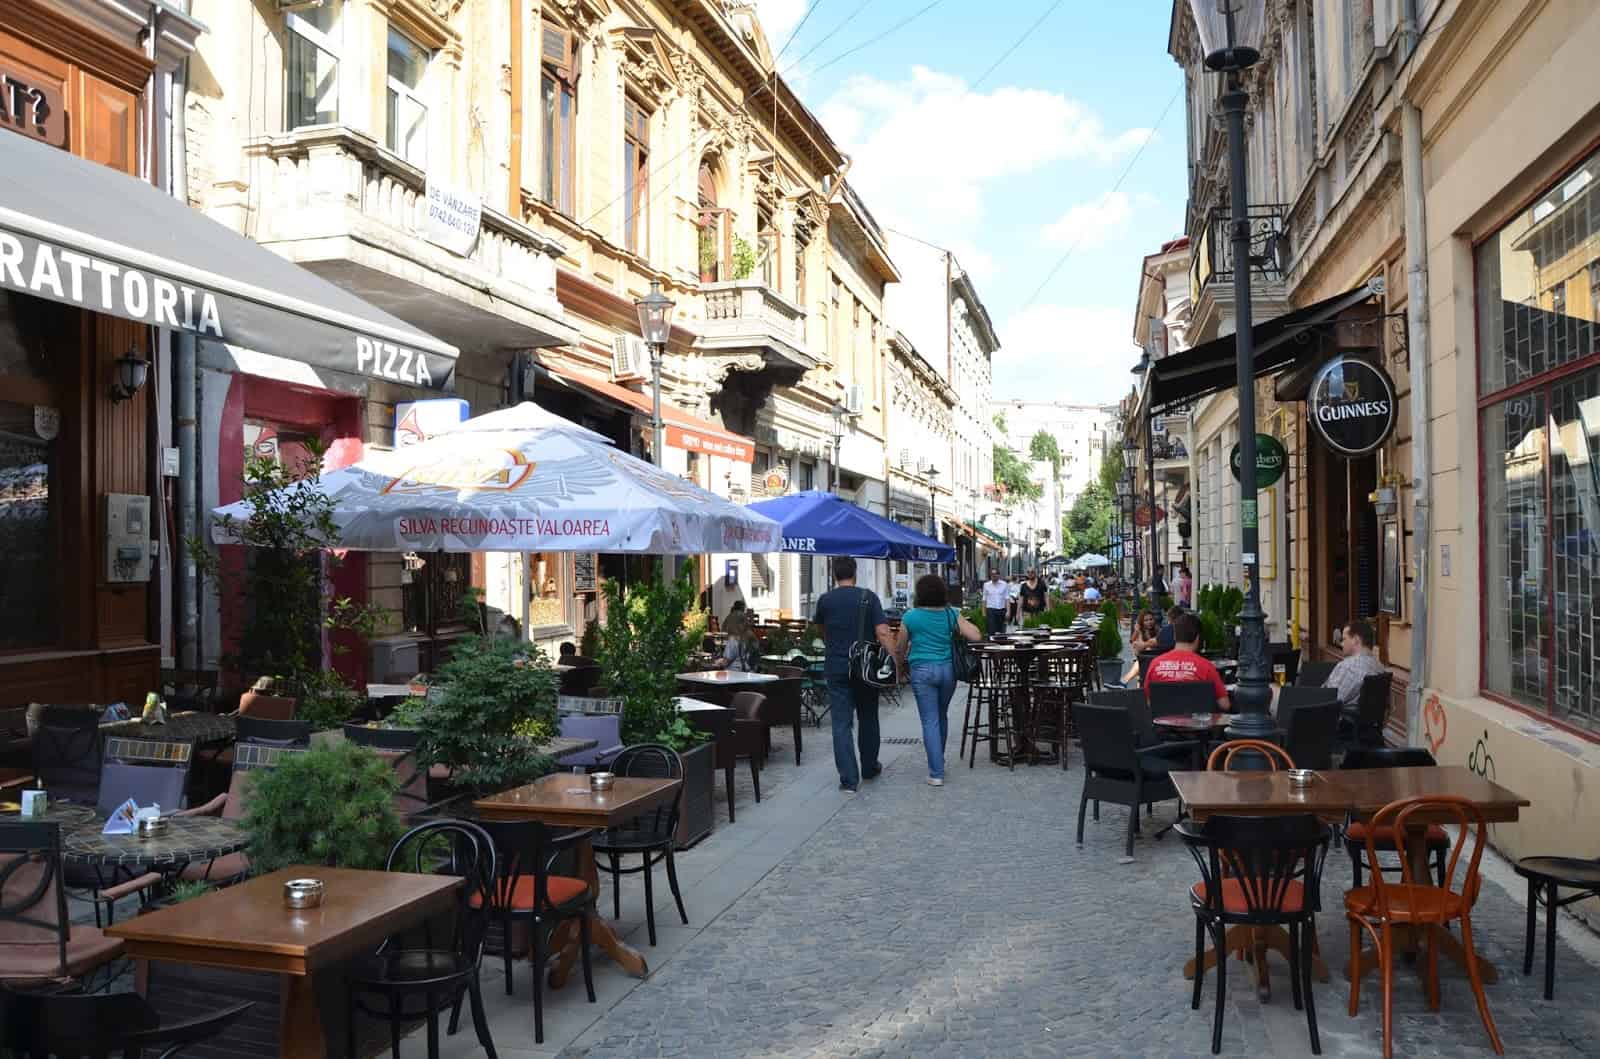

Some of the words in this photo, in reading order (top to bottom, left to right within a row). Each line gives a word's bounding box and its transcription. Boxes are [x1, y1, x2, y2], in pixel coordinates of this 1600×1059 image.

[430, 185, 441, 202] DE
[0, 232, 223, 337] RATTORIA
[356, 336, 433, 387] PIZZA
[1319, 401, 1388, 421] GUINNESS
[399, 519, 437, 536] SILVA
[536, 519, 610, 536] VALOAREA
